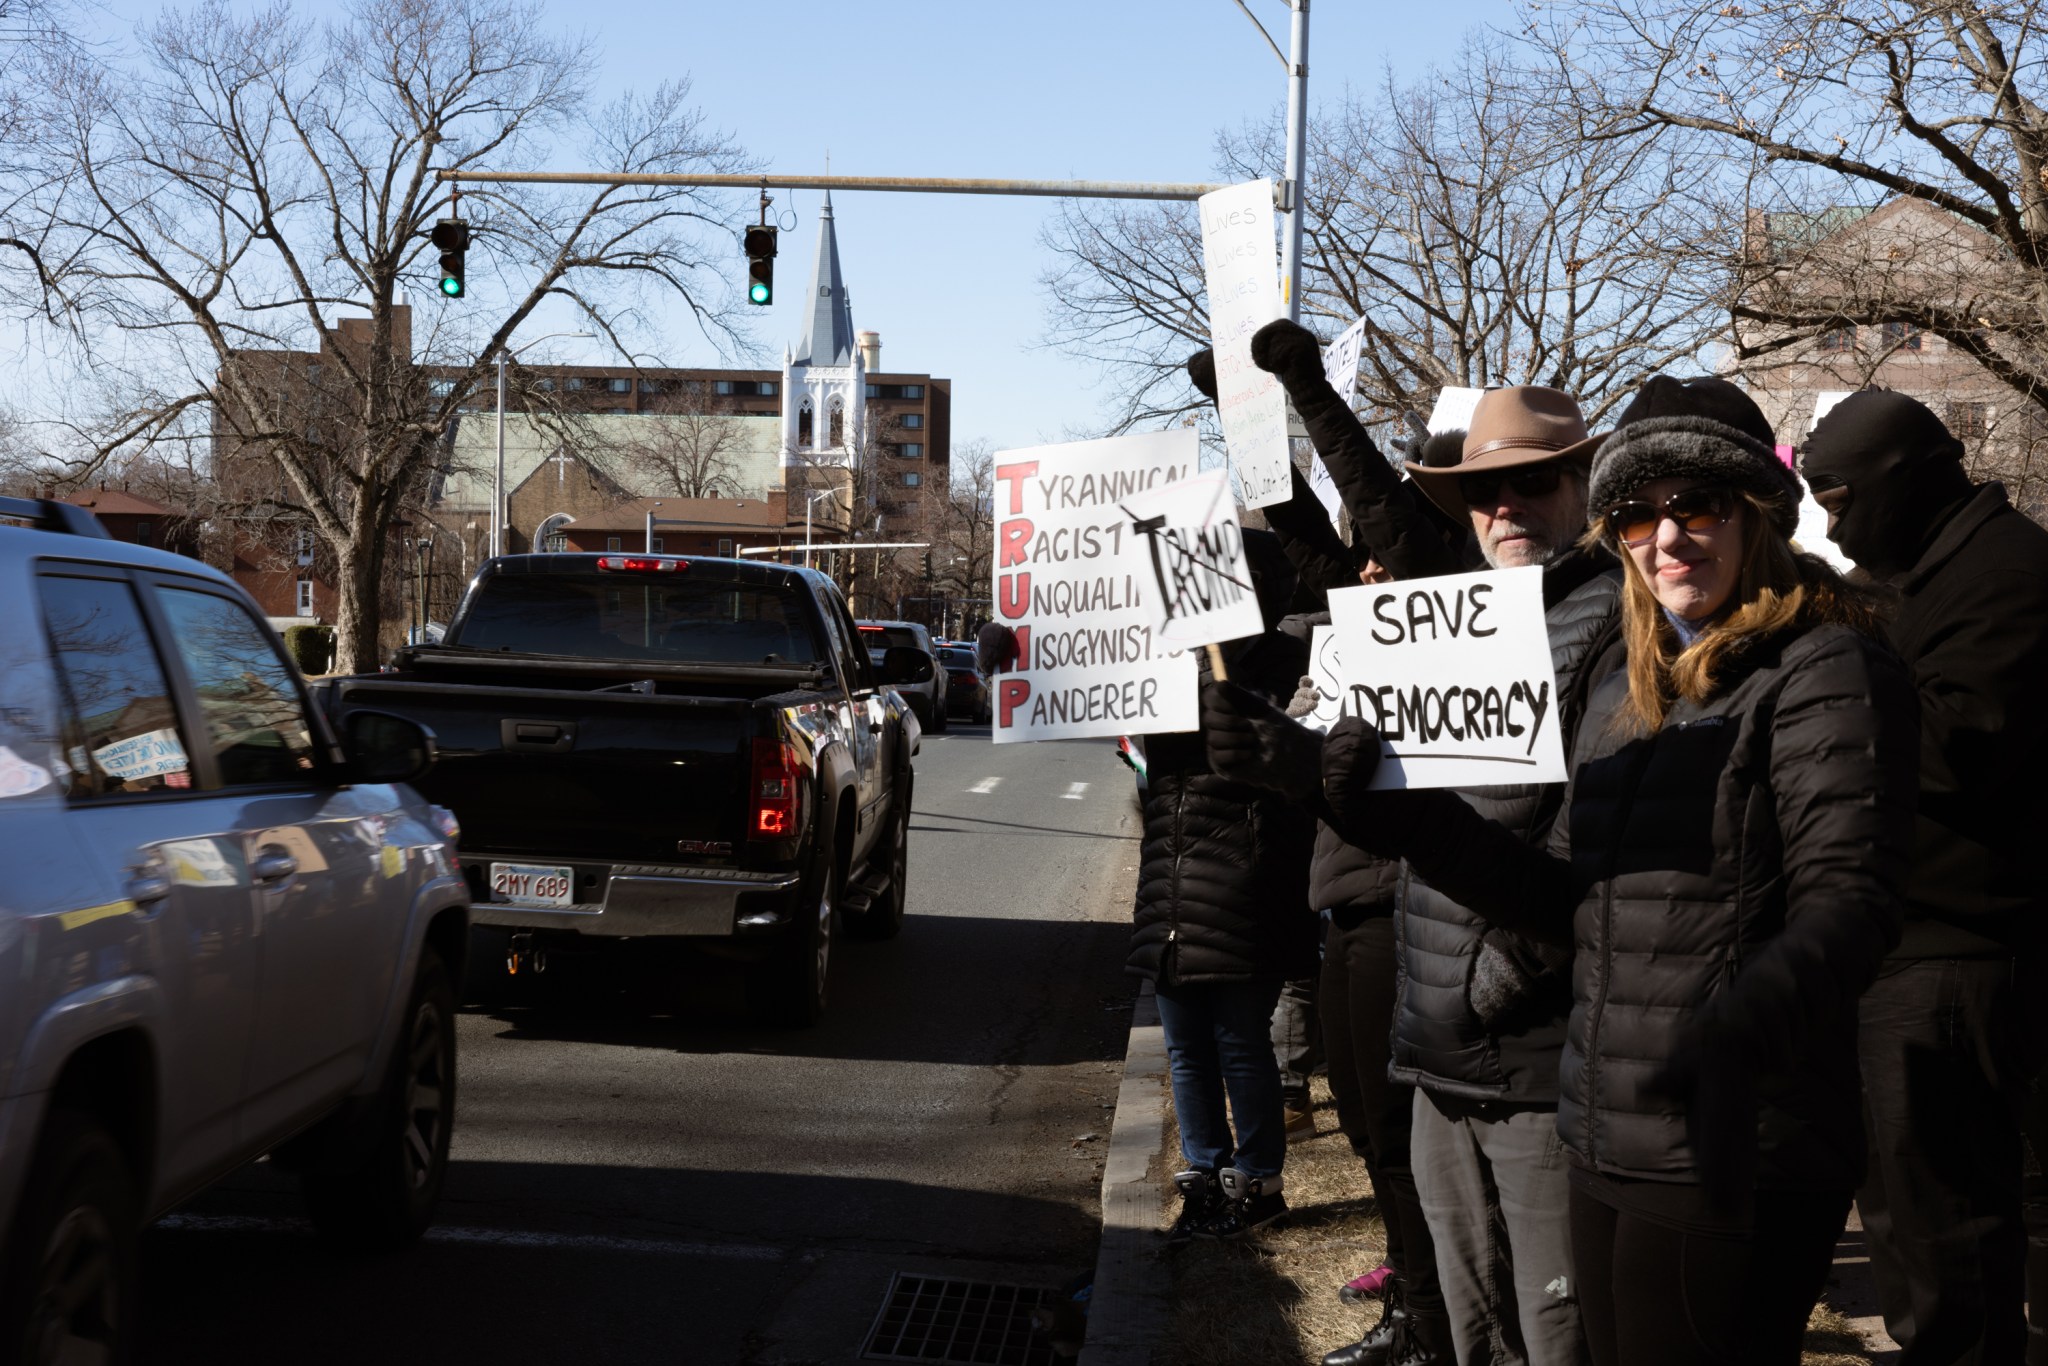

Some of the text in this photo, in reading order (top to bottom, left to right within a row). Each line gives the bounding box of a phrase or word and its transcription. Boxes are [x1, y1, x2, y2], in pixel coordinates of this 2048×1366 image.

[1203, 204, 1257, 236] Lives
[1213, 241, 1257, 269] Lives
[1220, 277, 1258, 304] Lives
[1226, 315, 1257, 342] Lives
[1325, 327, 1363, 382] ROTECT
[1288, 413, 1304, 425] RIG
[1000, 518, 1125, 569] RACIST
[1000, 572, 1140, 619] UNQUALI
[1371, 583, 1498, 645] SAVE
[999, 624, 1185, 674] MISOGYNIST
[999, 677, 1159, 729] PANDERER
[1349, 679, 1549, 756] DEMOCRACY
[677, 839, 733, 856] GMC
[494, 873, 569, 898] 2MY 689
